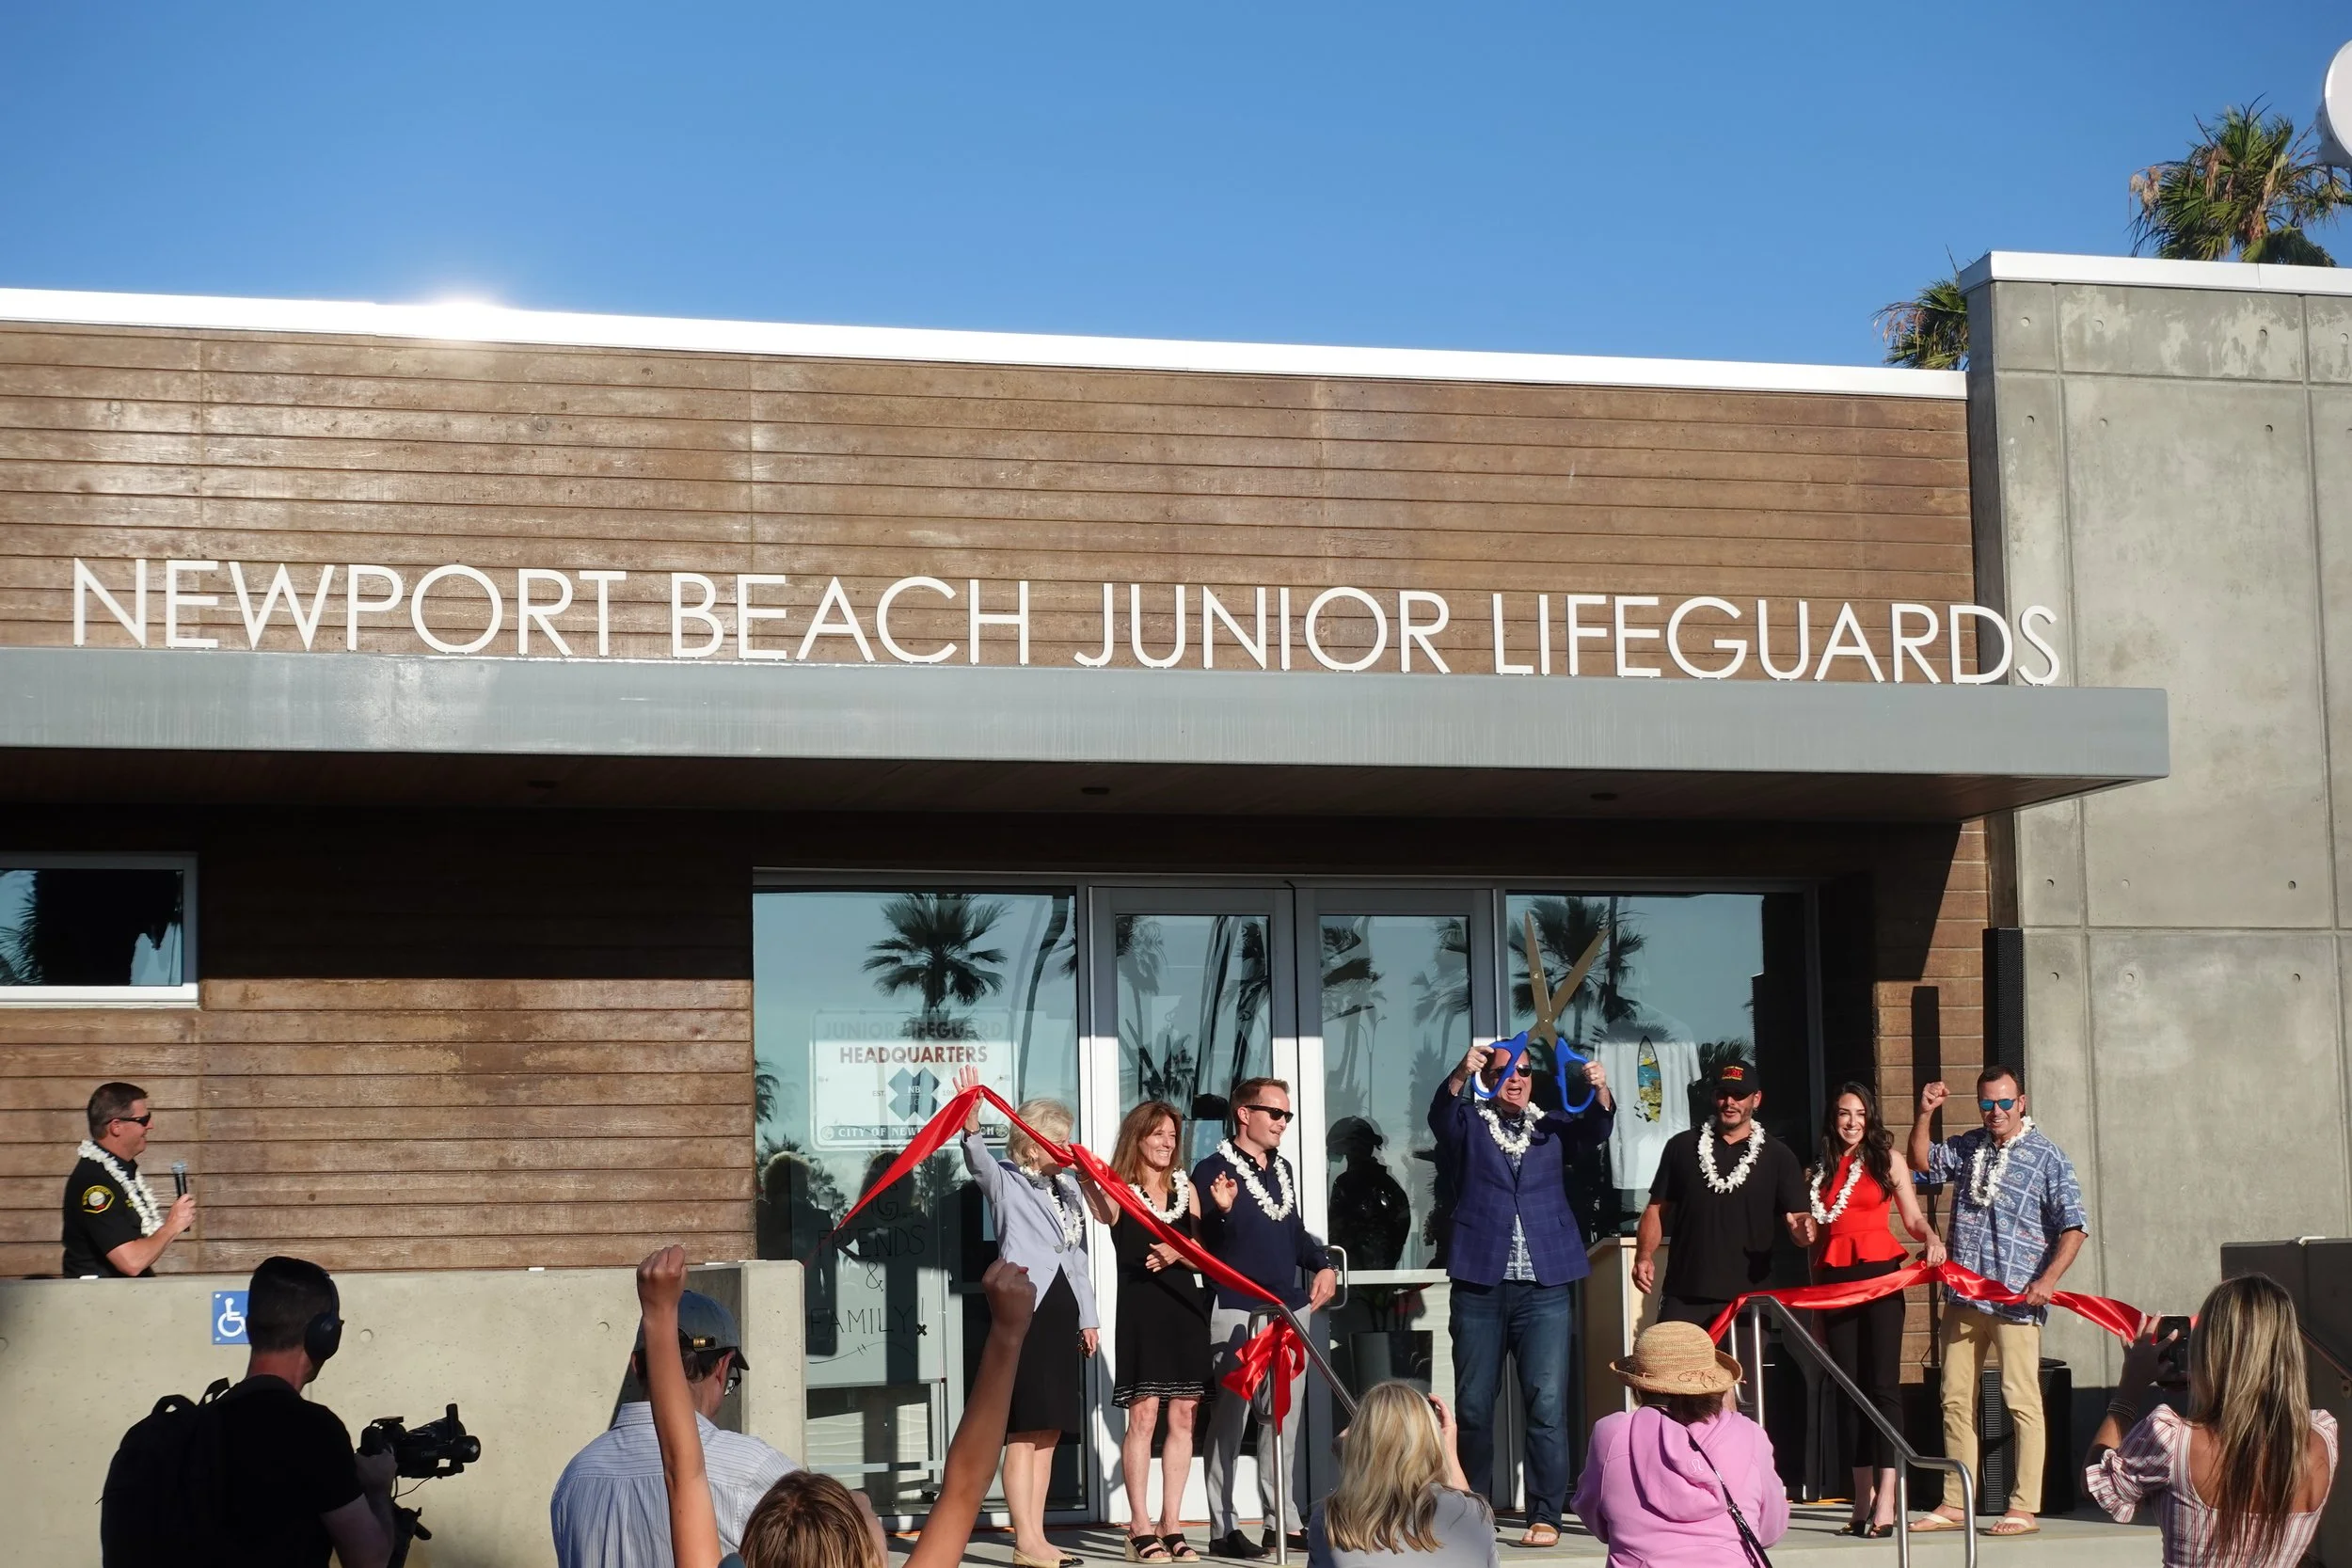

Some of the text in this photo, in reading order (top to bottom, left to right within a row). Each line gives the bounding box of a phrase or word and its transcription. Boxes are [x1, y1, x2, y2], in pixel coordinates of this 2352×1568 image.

[72, 556, 2060, 686] NEWPORT BEACH JUNIOR LIFEGUARDS
[823, 1022, 896, 1038] JUNIOR
[839, 1046, 988, 1064] HEADQUARTERS
[908, 1085, 921, 1094] NB
[838, 1128, 866, 1137] CITY
[871, 1128, 886, 1136] OF
[817, 1224, 927, 1258] FRIENDS
[866, 1260, 883, 1292] &
